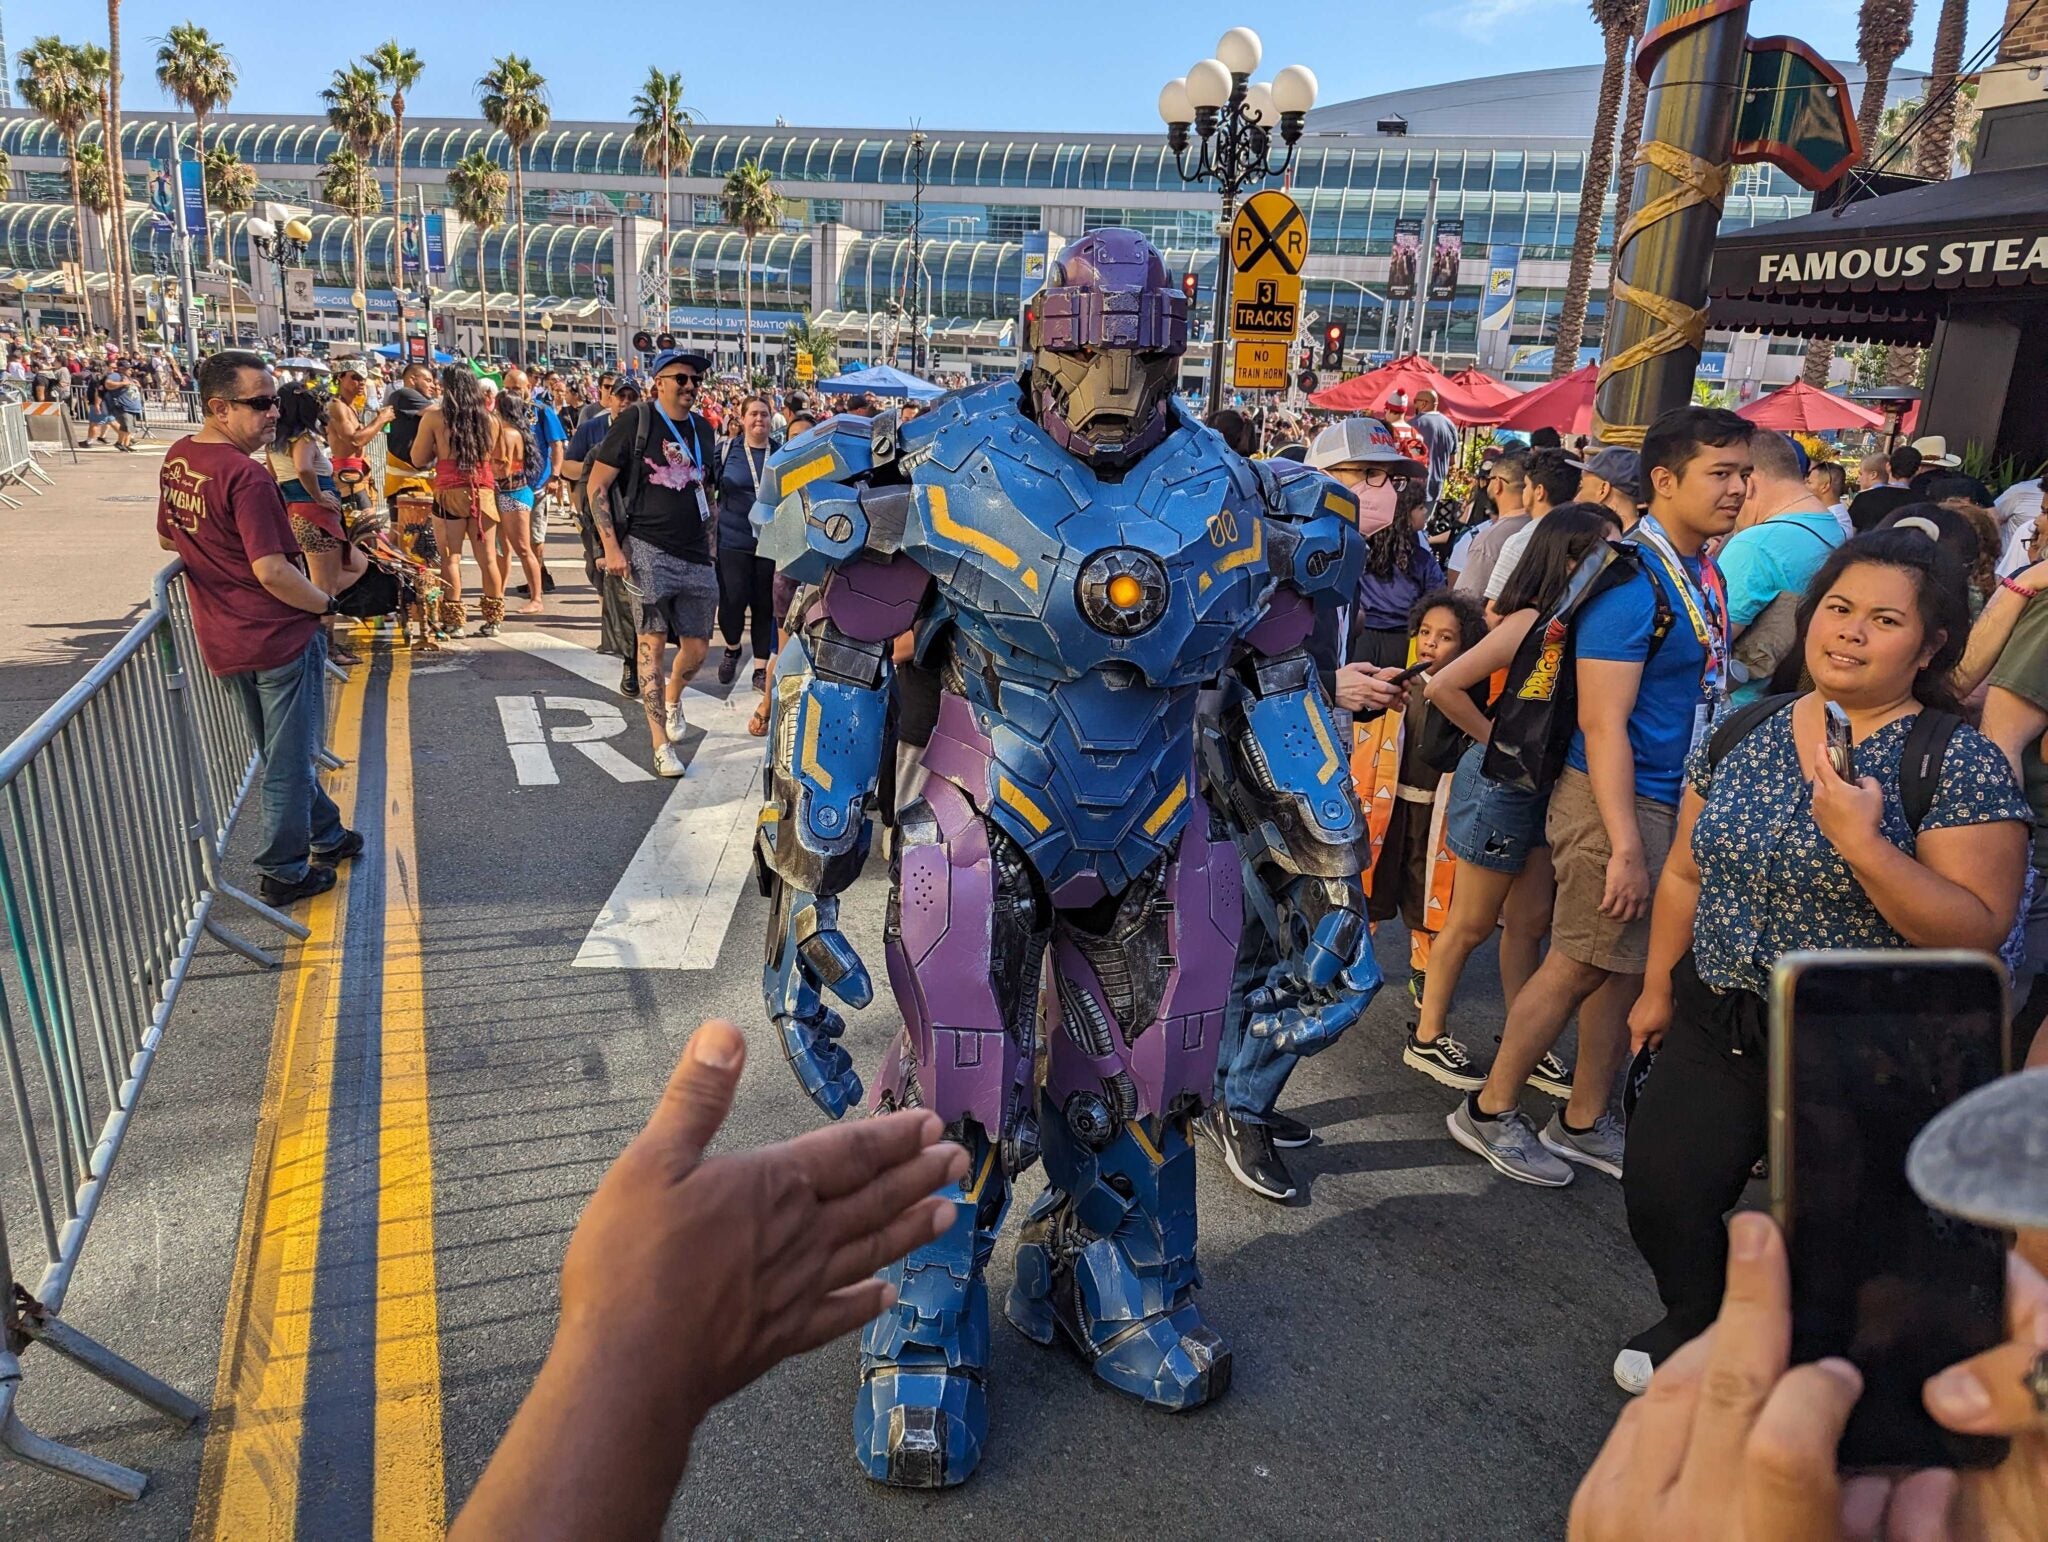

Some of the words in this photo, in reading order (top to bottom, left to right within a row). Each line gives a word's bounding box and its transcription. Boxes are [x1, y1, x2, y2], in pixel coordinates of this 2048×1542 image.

[1237, 227, 1252, 251] R
[1288, 231, 1302, 254] R
[1758, 245, 1929, 283] FAMOUS
[1936, 236, 2048, 275] STEA
[1261, 285, 1272, 303] 3
[669, 315, 723, 327] COMIC-CON
[726, 318, 803, 330] INTRNATIONL
[1238, 309, 1292, 327] TRACKS
[1254, 350, 1269, 362] NO
[1238, 367, 1260, 379] TRAIN
[1264, 367, 1284, 379] HORN
[495, 695, 657, 785] R
